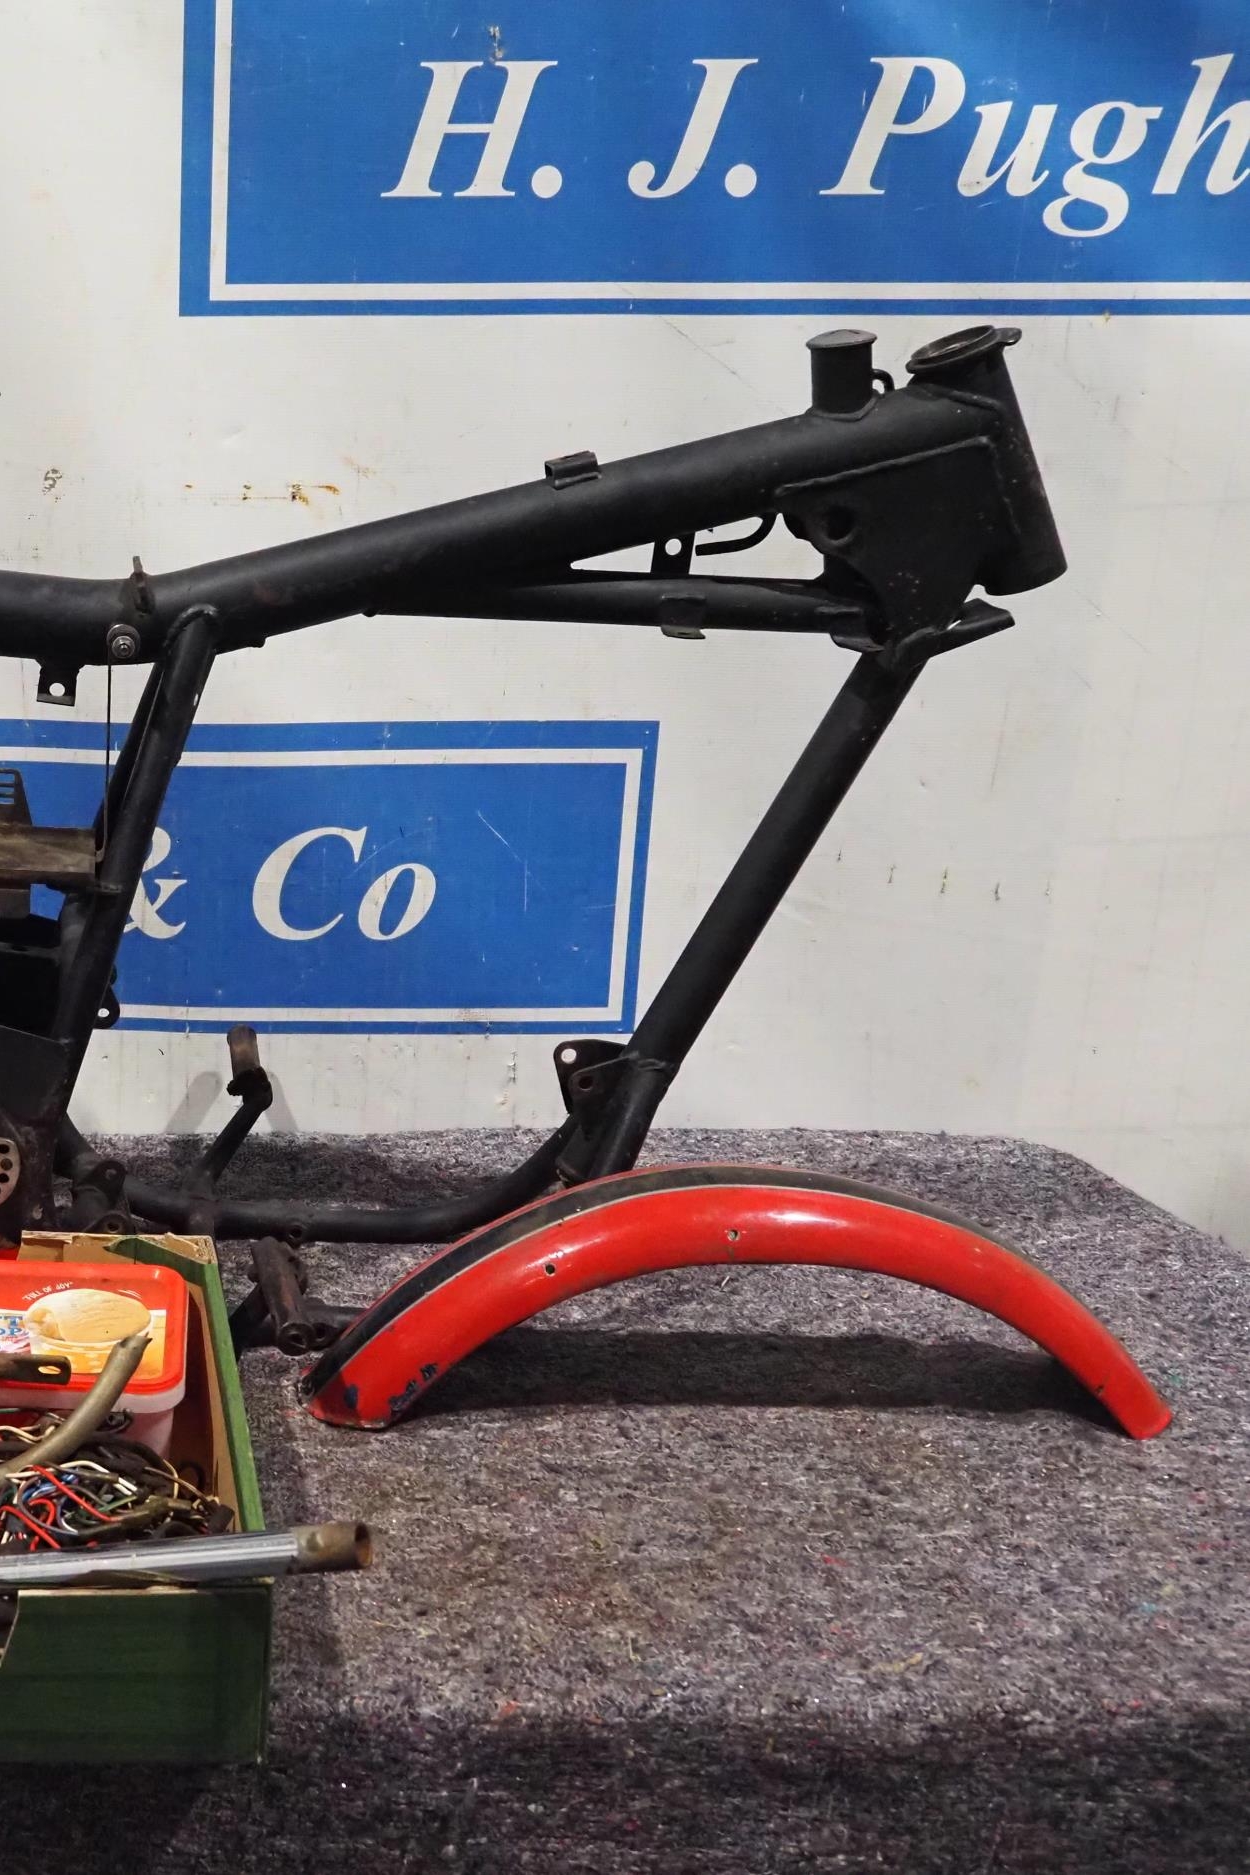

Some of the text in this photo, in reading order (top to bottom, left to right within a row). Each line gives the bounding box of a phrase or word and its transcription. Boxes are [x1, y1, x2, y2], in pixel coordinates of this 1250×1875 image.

[380, 54, 1250, 238] H. J. Pugh
[252, 826, 437, 941] Co
